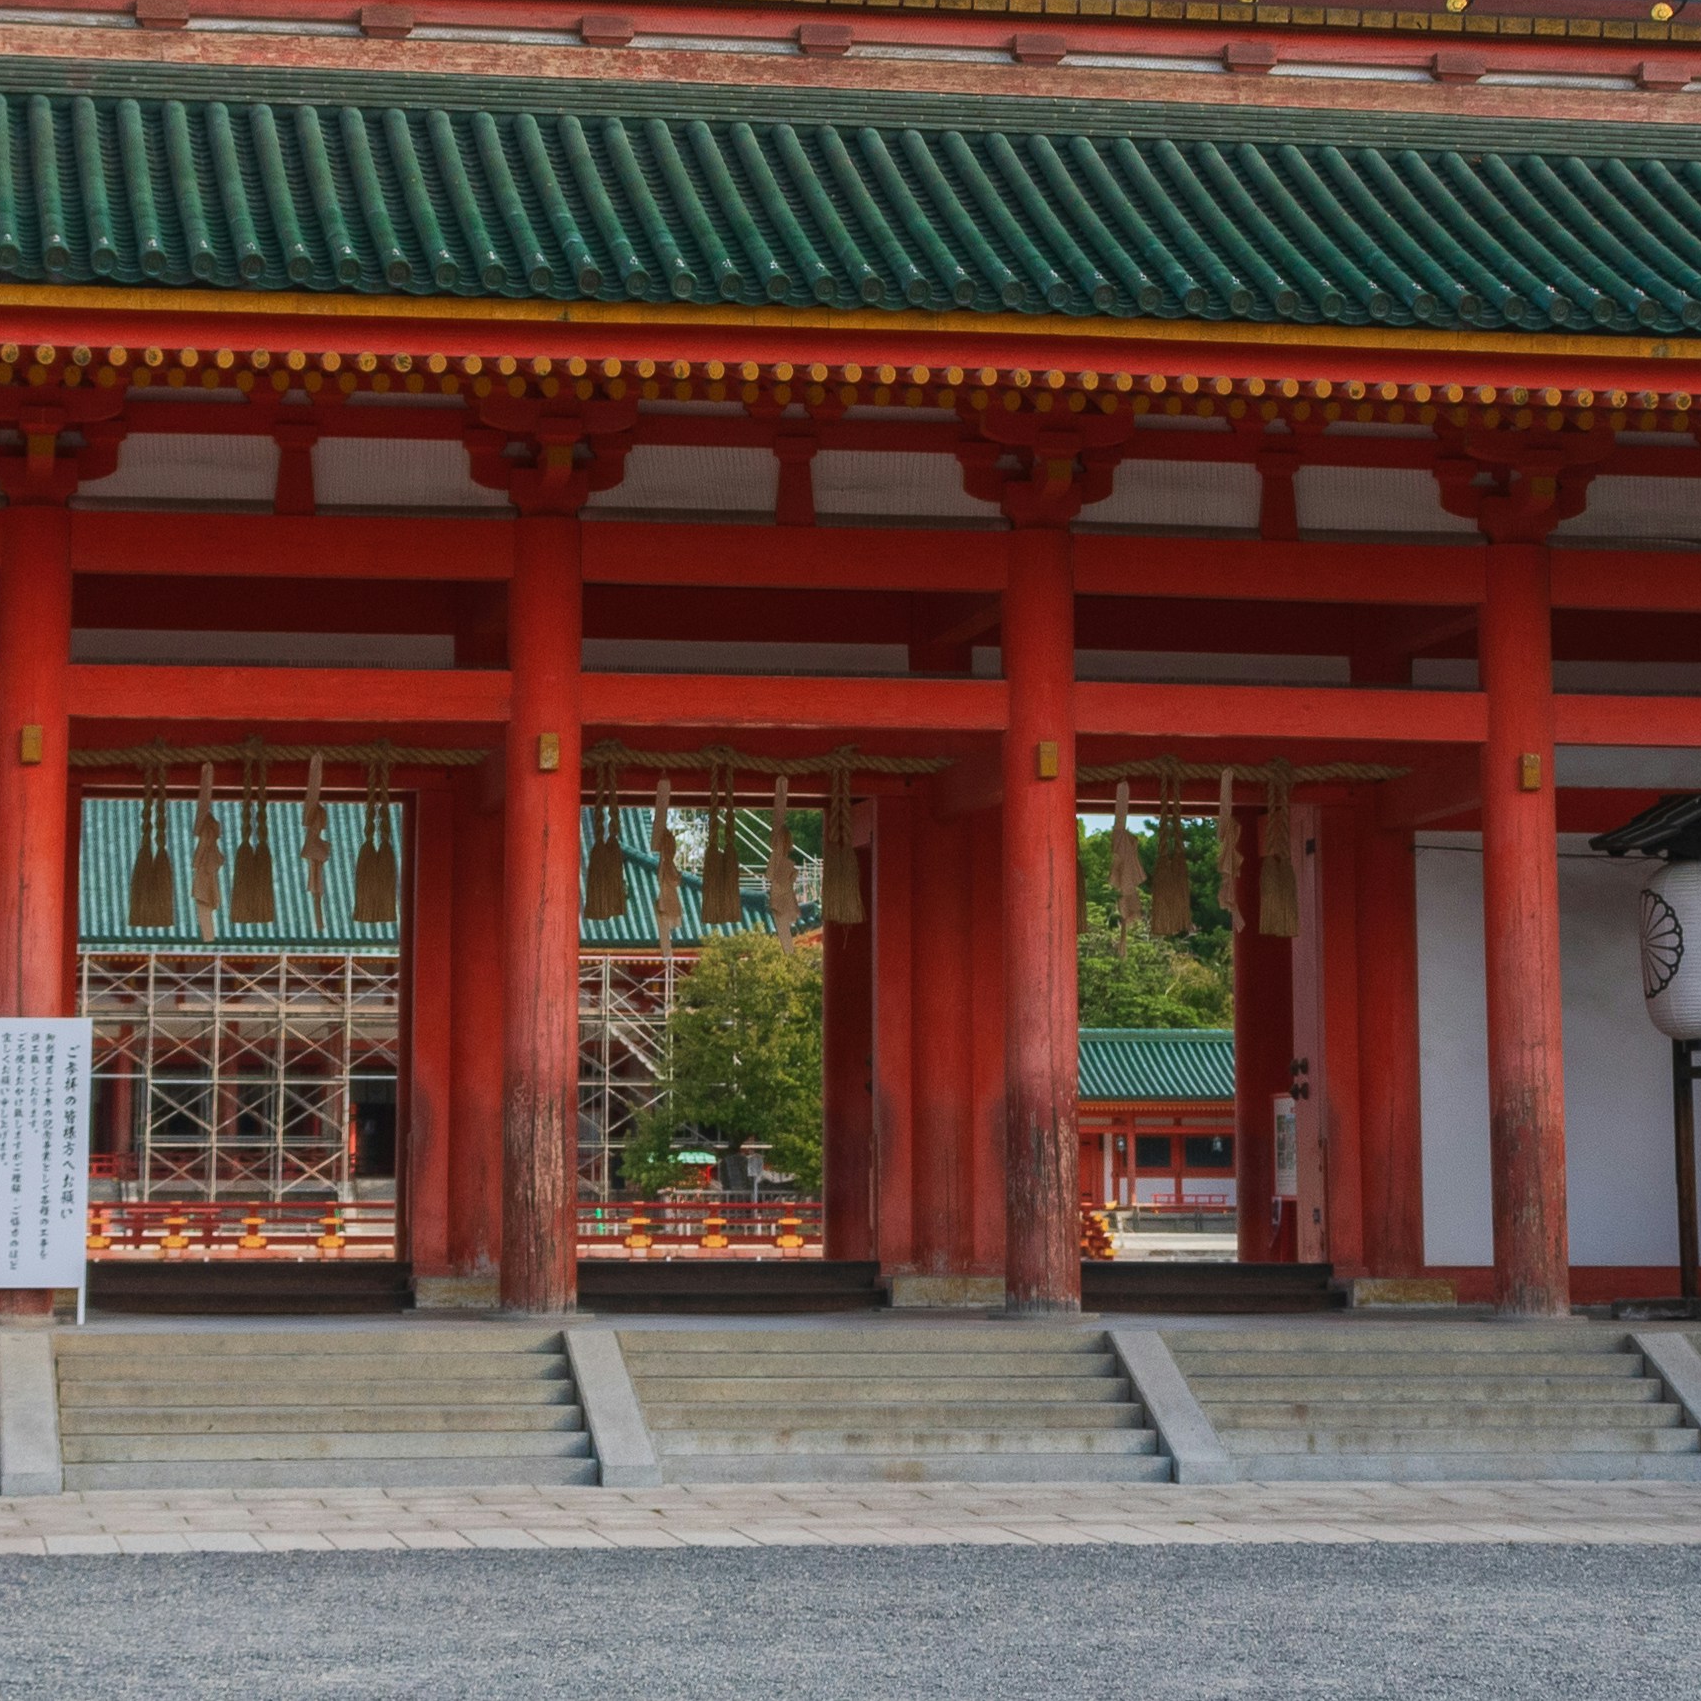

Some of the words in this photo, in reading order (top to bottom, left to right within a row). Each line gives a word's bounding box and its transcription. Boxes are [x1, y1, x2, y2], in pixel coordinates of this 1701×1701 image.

[60, 1044, 81, 1219] ご参拝の皆様方へお願い
